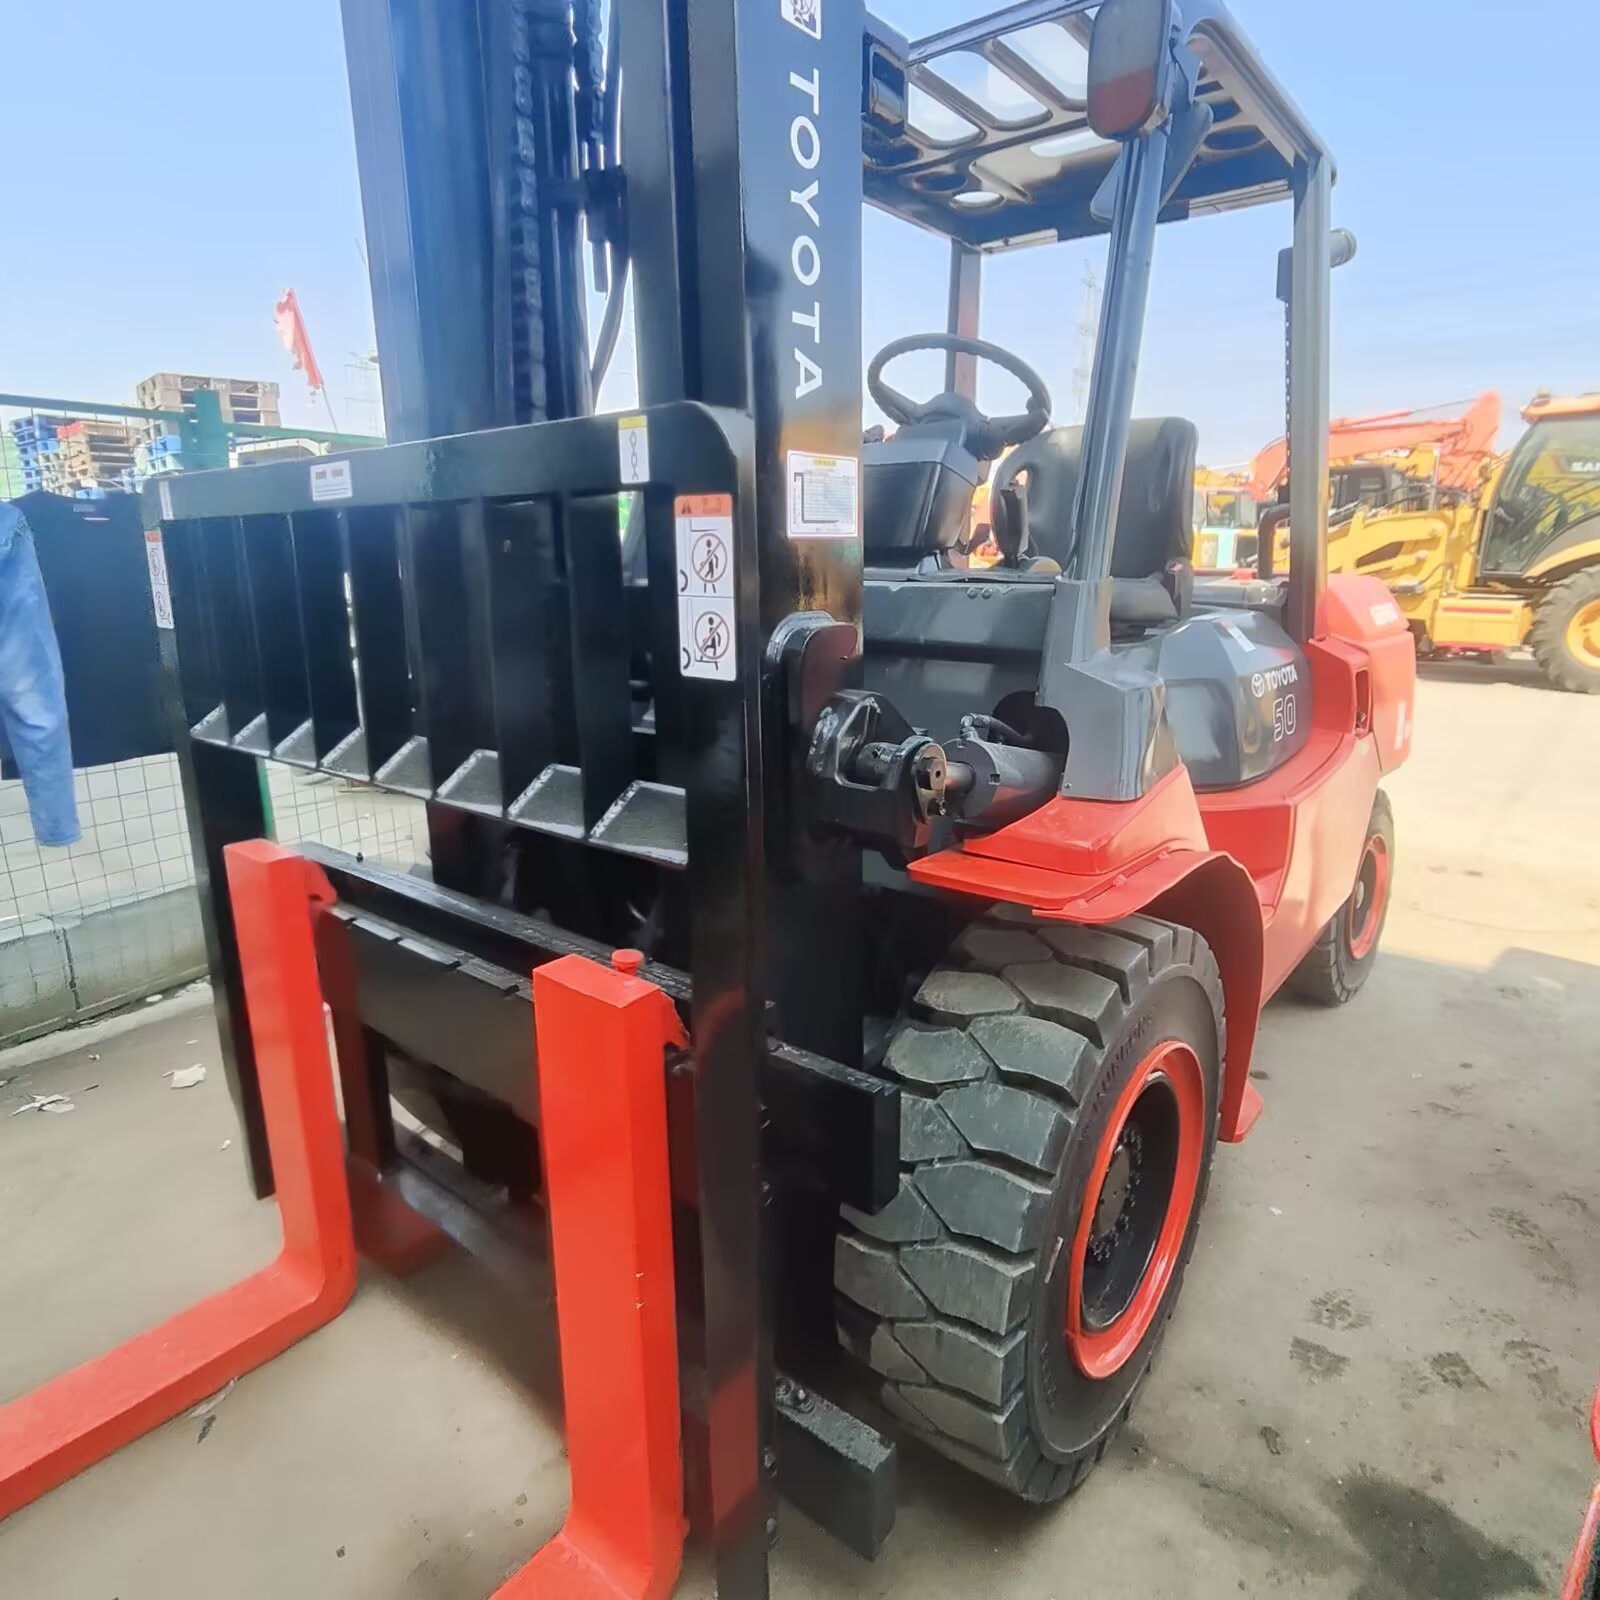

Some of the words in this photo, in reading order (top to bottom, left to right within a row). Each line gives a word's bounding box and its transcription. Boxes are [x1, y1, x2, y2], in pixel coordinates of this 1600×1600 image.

[789, 68, 823, 400] TOYOTA
[1264, 664, 1298, 691] TOYOTA
[1272, 693, 1296, 742] 50
